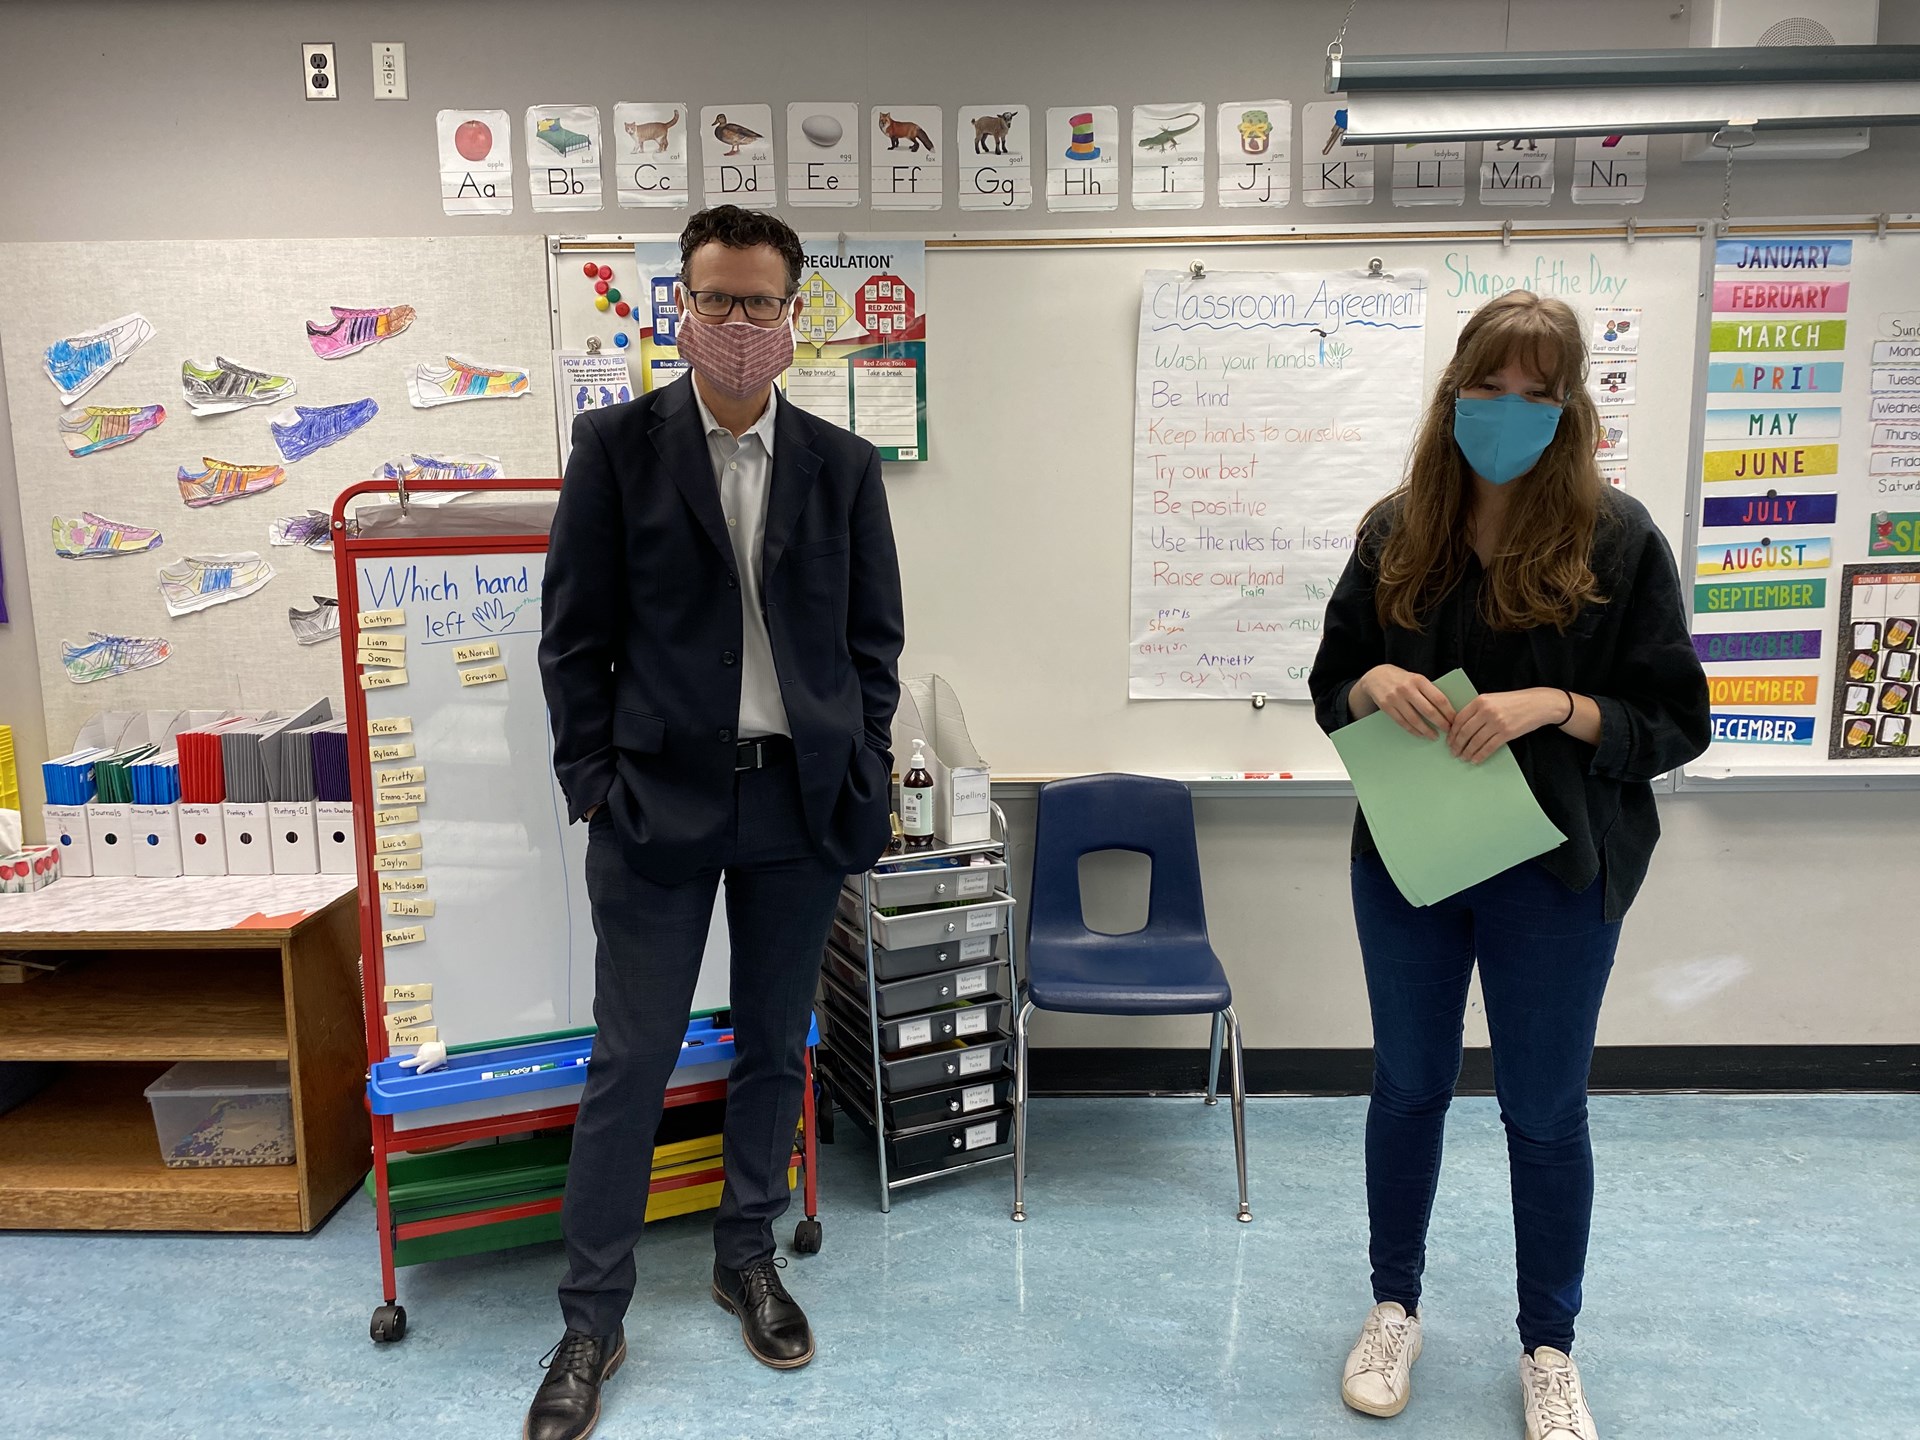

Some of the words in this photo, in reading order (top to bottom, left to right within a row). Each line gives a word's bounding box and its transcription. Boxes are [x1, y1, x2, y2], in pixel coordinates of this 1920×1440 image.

[581, 156, 594, 164] bed
[752, 153, 766, 161] duck
[840, 154, 852, 162] egg
[1009, 156, 1023, 165] goat
[1178, 155, 1198, 164] iguana
[1270, 153, 1284, 162] jam
[1356, 150, 1368, 160] key
[1434, 150, 1459, 159] ladybug
[1523, 151, 1548, 159] monkey
[487, 161, 504, 169] apple
[635, 164, 670, 190] Cc
[721, 166, 757, 192] Dd
[808, 163, 839, 190] Ee
[892, 166, 921, 193] Ff
[1161, 166, 1175, 192] Ii
[1322, 162, 1355, 190] Kk
[1491, 161, 1542, 189] Mm
[1591, 160, 1628, 187] Nn
[458, 172, 496, 198] Aa
[548, 168, 584, 195] Bb
[975, 167, 1014, 206] Gg
[1065, 169, 1101, 195] Hh
[1238, 163, 1270, 202] Jj
[1737, 246, 1832, 269] JANUARY
[1445, 253, 1515, 299] Shape
[1523, 256, 1546, 291] of
[1546, 259, 1580, 294] the
[1590, 253, 1627, 303] Day
[1732, 285, 1831, 308] FEBRUARY
[1153, 282, 1295, 320] Classroom
[1304, 279, 1427, 334] Agreement
[1737, 325, 1820, 348] MARCH
[1593, 344, 1607, 352] Rest
[1155, 343, 1207, 370] Wash
[1222, 354, 1258, 378] your
[1267, 343, 1316, 369] hands
[799, 369, 812, 377] Deep
[814, 369, 836, 377] breaths
[1731, 367, 1818, 390] APRIL
[1152, 380, 1182, 408] Be
[1196, 380, 1229, 407] kind
[1601, 396, 1625, 404] Library
[1749, 413, 1798, 436] MAY
[1149, 417, 1196, 450] Keep
[1204, 417, 1255, 443] hands
[1261, 417, 1279, 441] to
[1285, 417, 1362, 443] ourselves
[1597, 451, 1614, 459] Story
[1147, 455, 1175, 488] Try
[1183, 465, 1210, 480] our
[1219, 453, 1258, 480] best
[1735, 450, 1805, 477] JUNE
[1153, 490, 1181, 515] Be
[1192, 490, 1267, 520] positive
[1743, 501, 1796, 522] JULY
[1151, 526, 1186, 552] Use
[1196, 526, 1224, 550] the
[1230, 530, 1265, 551] rules
[1271, 526, 1294, 550] for
[1722, 545, 1807, 570] AUGUST
[1153, 561, 1204, 587] Raise
[1211, 573, 1241, 586] our
[1249, 564, 1284, 586] hand
[364, 565, 458, 608] Which
[475, 565, 528, 595] hand
[1708, 584, 1814, 610] SEPTEMBER
[364, 615, 392, 624] Caitlyn
[426, 611, 465, 638] left
[367, 637, 388, 646] Liam
[1709, 634, 1805, 659] OCTOBER
[1872, 639, 1879, 652] 6
[1906, 637, 1913, 649] 7
[368, 653, 391, 663] Soren
[368, 676, 391, 685] Fraia
[465, 672, 498, 681] Grayson
[1864, 669, 1876, 682] 13
[1900, 669, 1911, 682] 14
[1856, 702, 1869, 714] 20
[1895, 701, 1908, 713] 21
[372, 723, 397, 733] Rares
[1860, 735, 1873, 747] 27
[1893, 733, 1906, 746] 28
[374, 748, 399, 759] Ryland
[381, 771, 414, 783] Arrietty
[381, 792, 421, 800] Emma-Jane
[955, 791, 987, 802] Spelling
[90, 808, 122, 817] Journals
[378, 813, 399, 822] Ivan
[383, 840, 407, 848] Lucas
[381, 858, 408, 868] Jaylyn
[395, 882, 425, 890] Madison
[386, 932, 416, 942] Ranbir
[393, 989, 415, 998] Paris
[395, 1033, 419, 1042] Arvin
